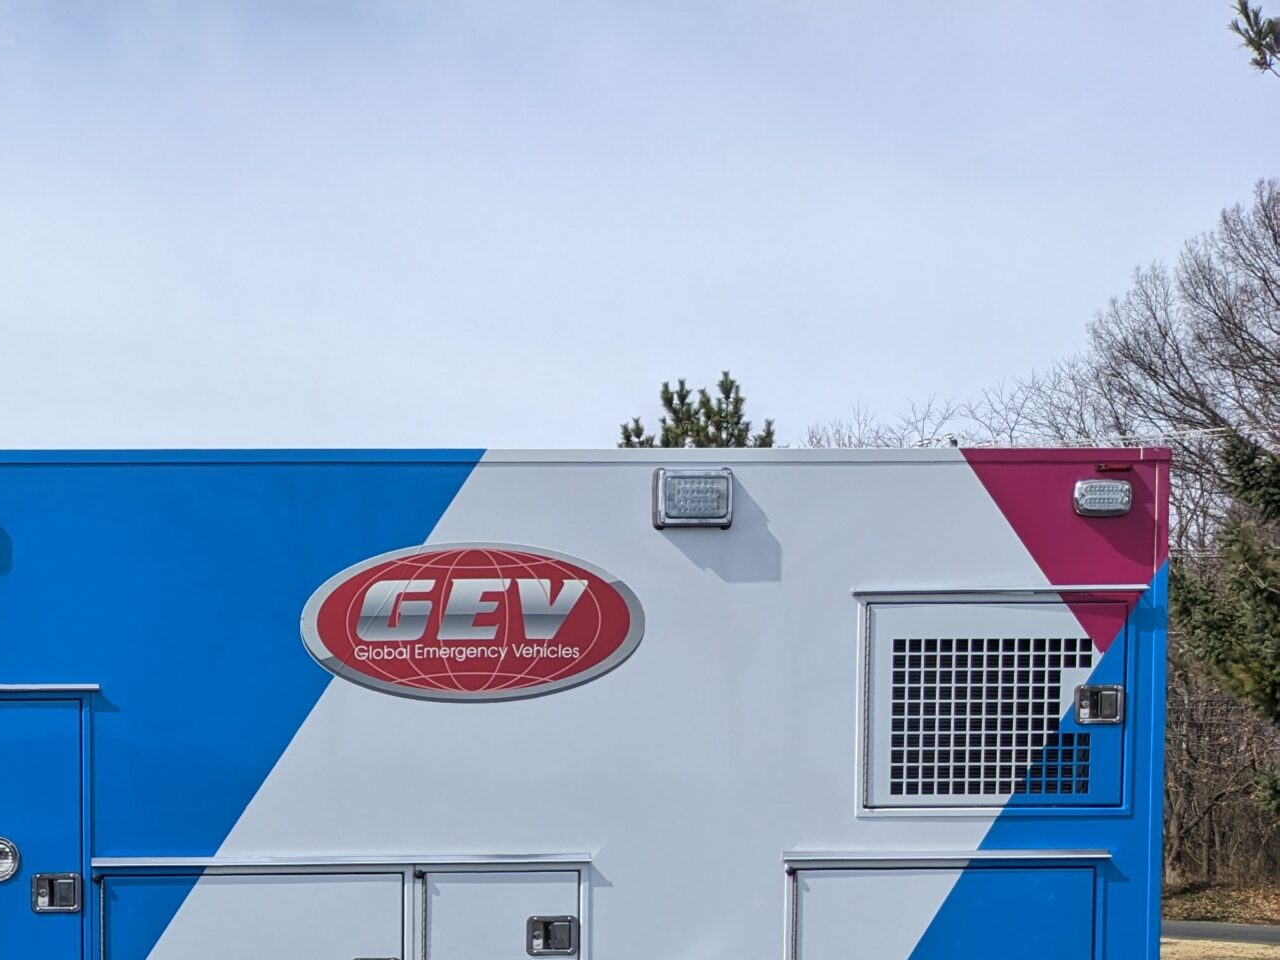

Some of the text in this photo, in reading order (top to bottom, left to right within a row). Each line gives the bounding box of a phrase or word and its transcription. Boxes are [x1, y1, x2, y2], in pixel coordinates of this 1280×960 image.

[355, 578, 589, 642] GEV
[354, 643, 580, 662] Global Emergency Vehicles
